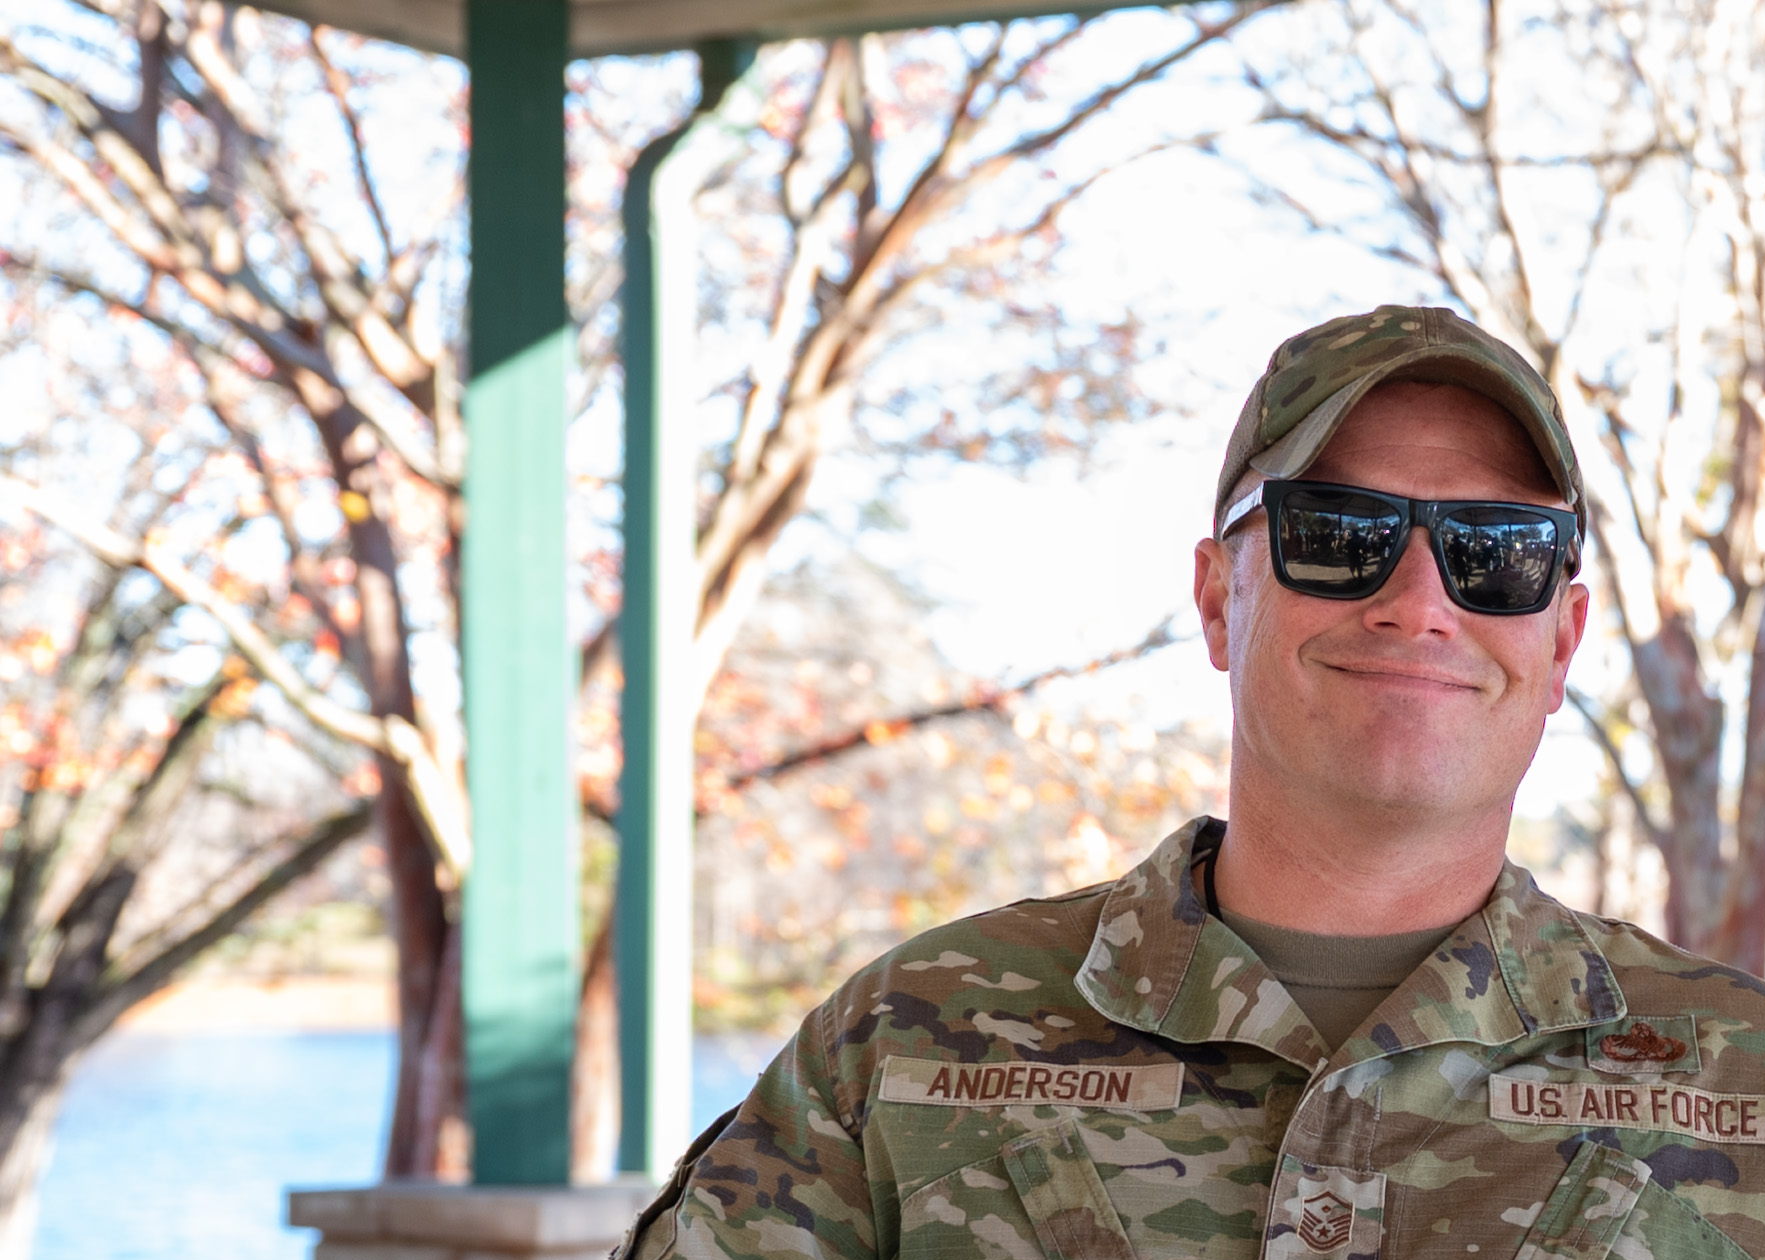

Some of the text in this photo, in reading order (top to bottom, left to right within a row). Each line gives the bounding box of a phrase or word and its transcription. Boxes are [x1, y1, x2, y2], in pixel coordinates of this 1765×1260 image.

[927, 1066, 1133, 1103] ANDERSON
[1511, 1083, 1759, 1138] U.S. AIR FORCE
